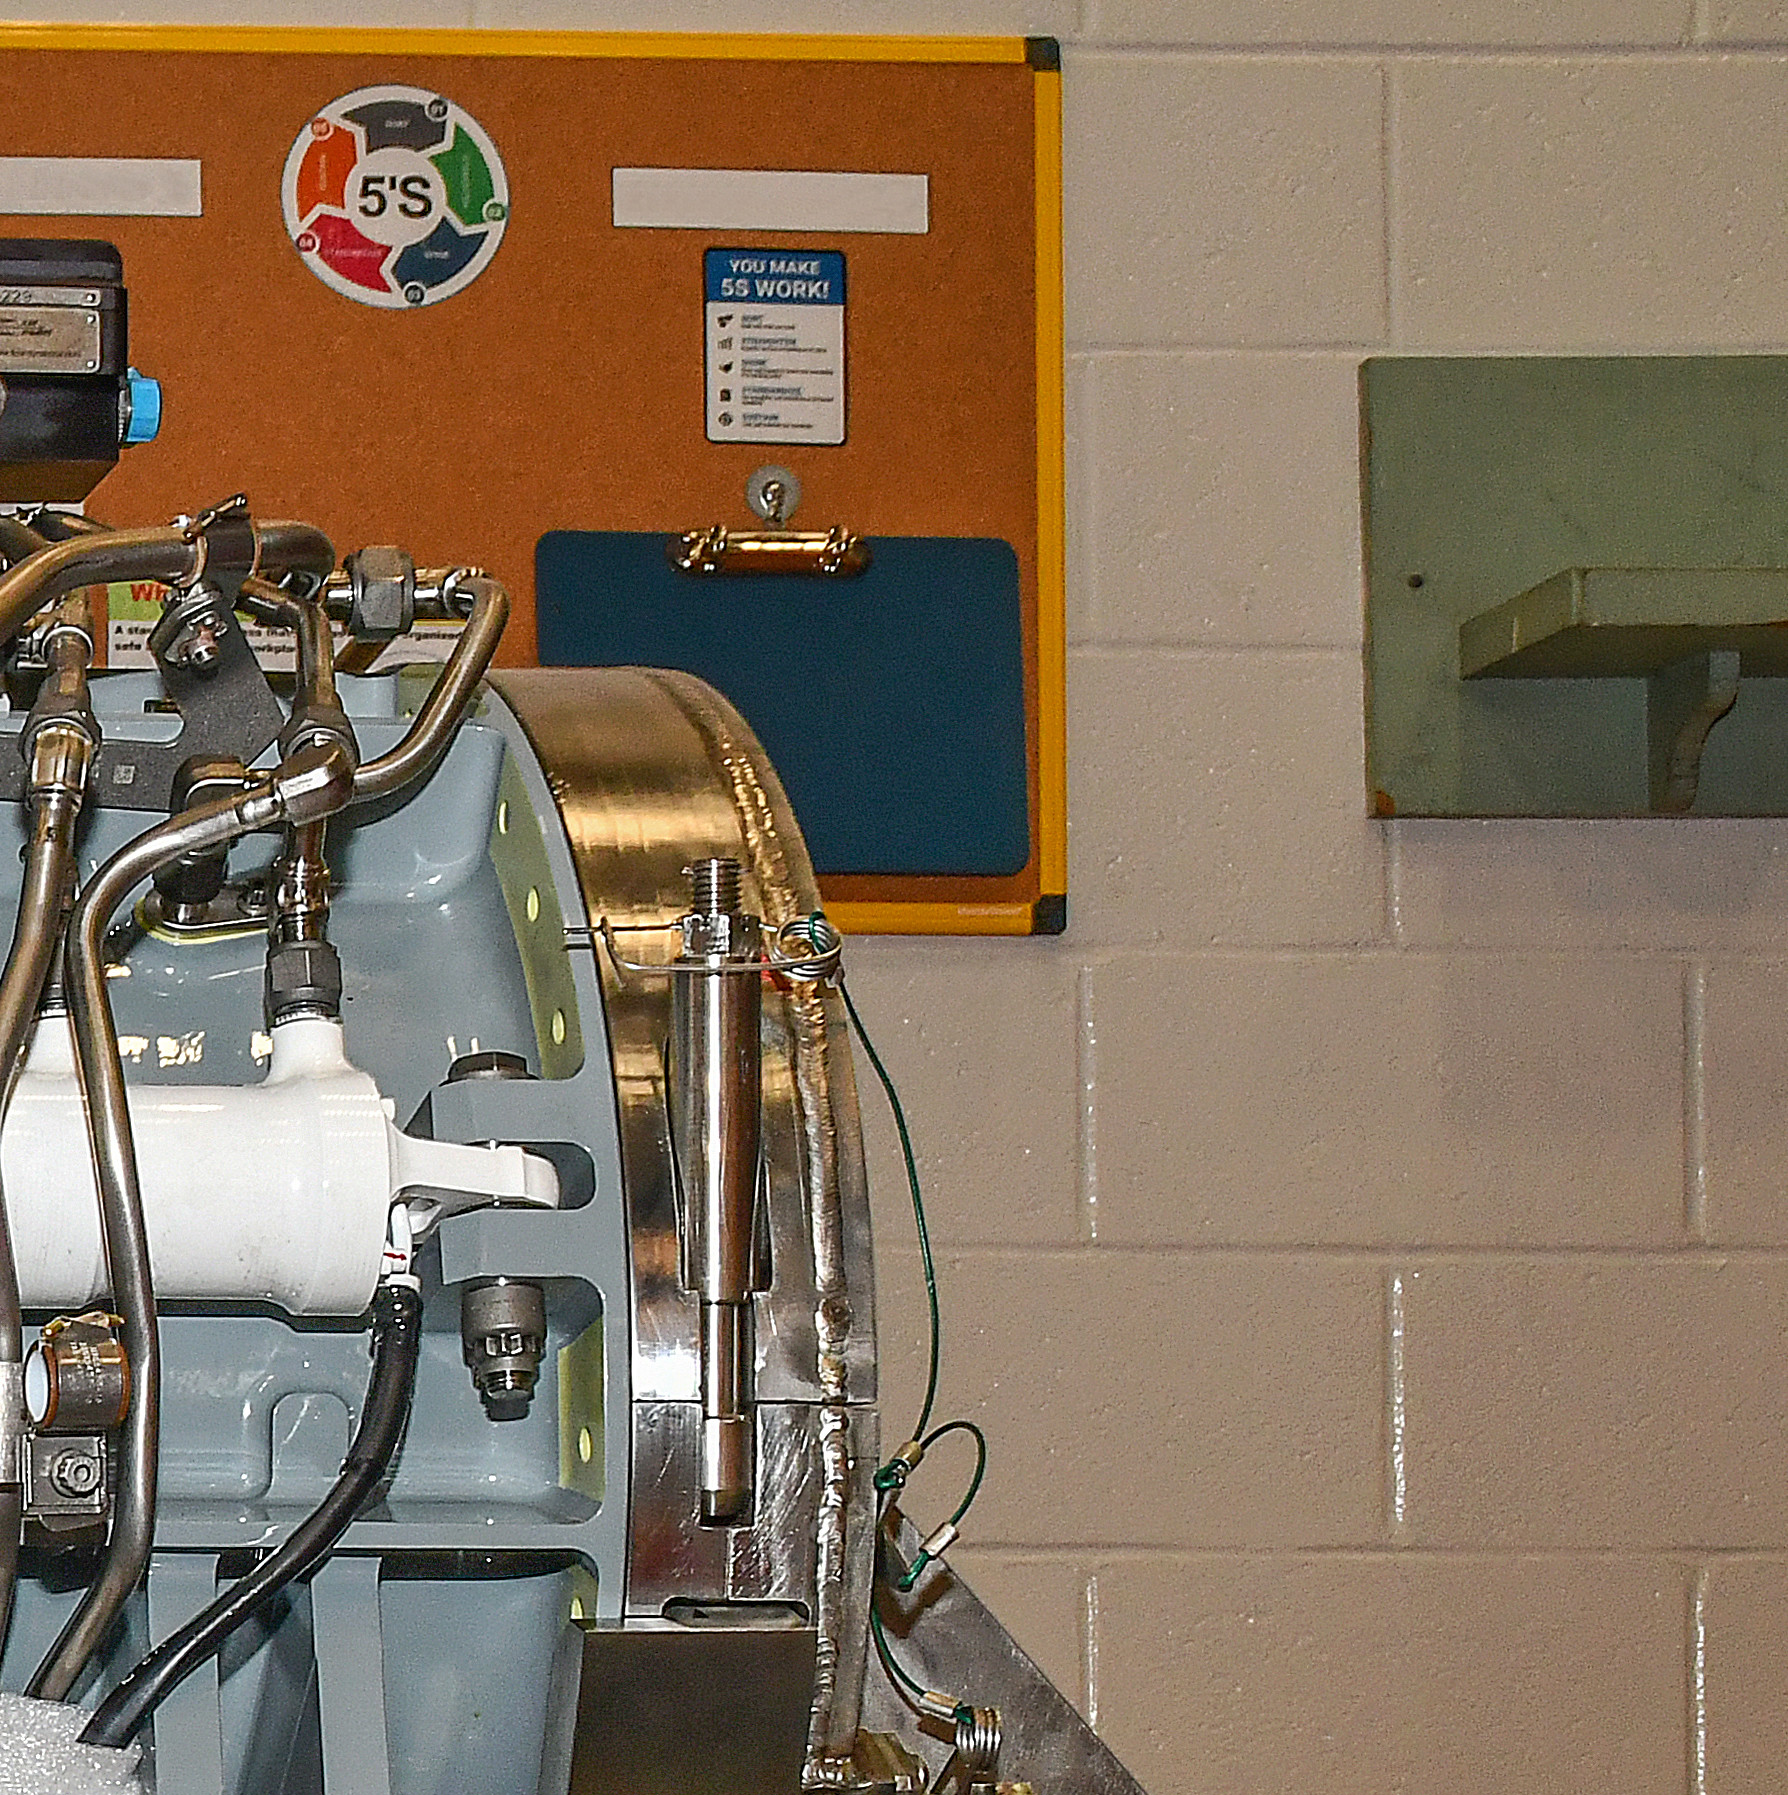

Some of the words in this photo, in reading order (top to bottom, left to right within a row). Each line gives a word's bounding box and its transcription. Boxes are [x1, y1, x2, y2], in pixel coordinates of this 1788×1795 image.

[358, 175, 433, 219] 5'S
[729, 259, 766, 273] YOU
[769, 259, 821, 275] MAKE
[720, 278, 750, 298] 5S
[755, 279, 830, 300] WORK!
